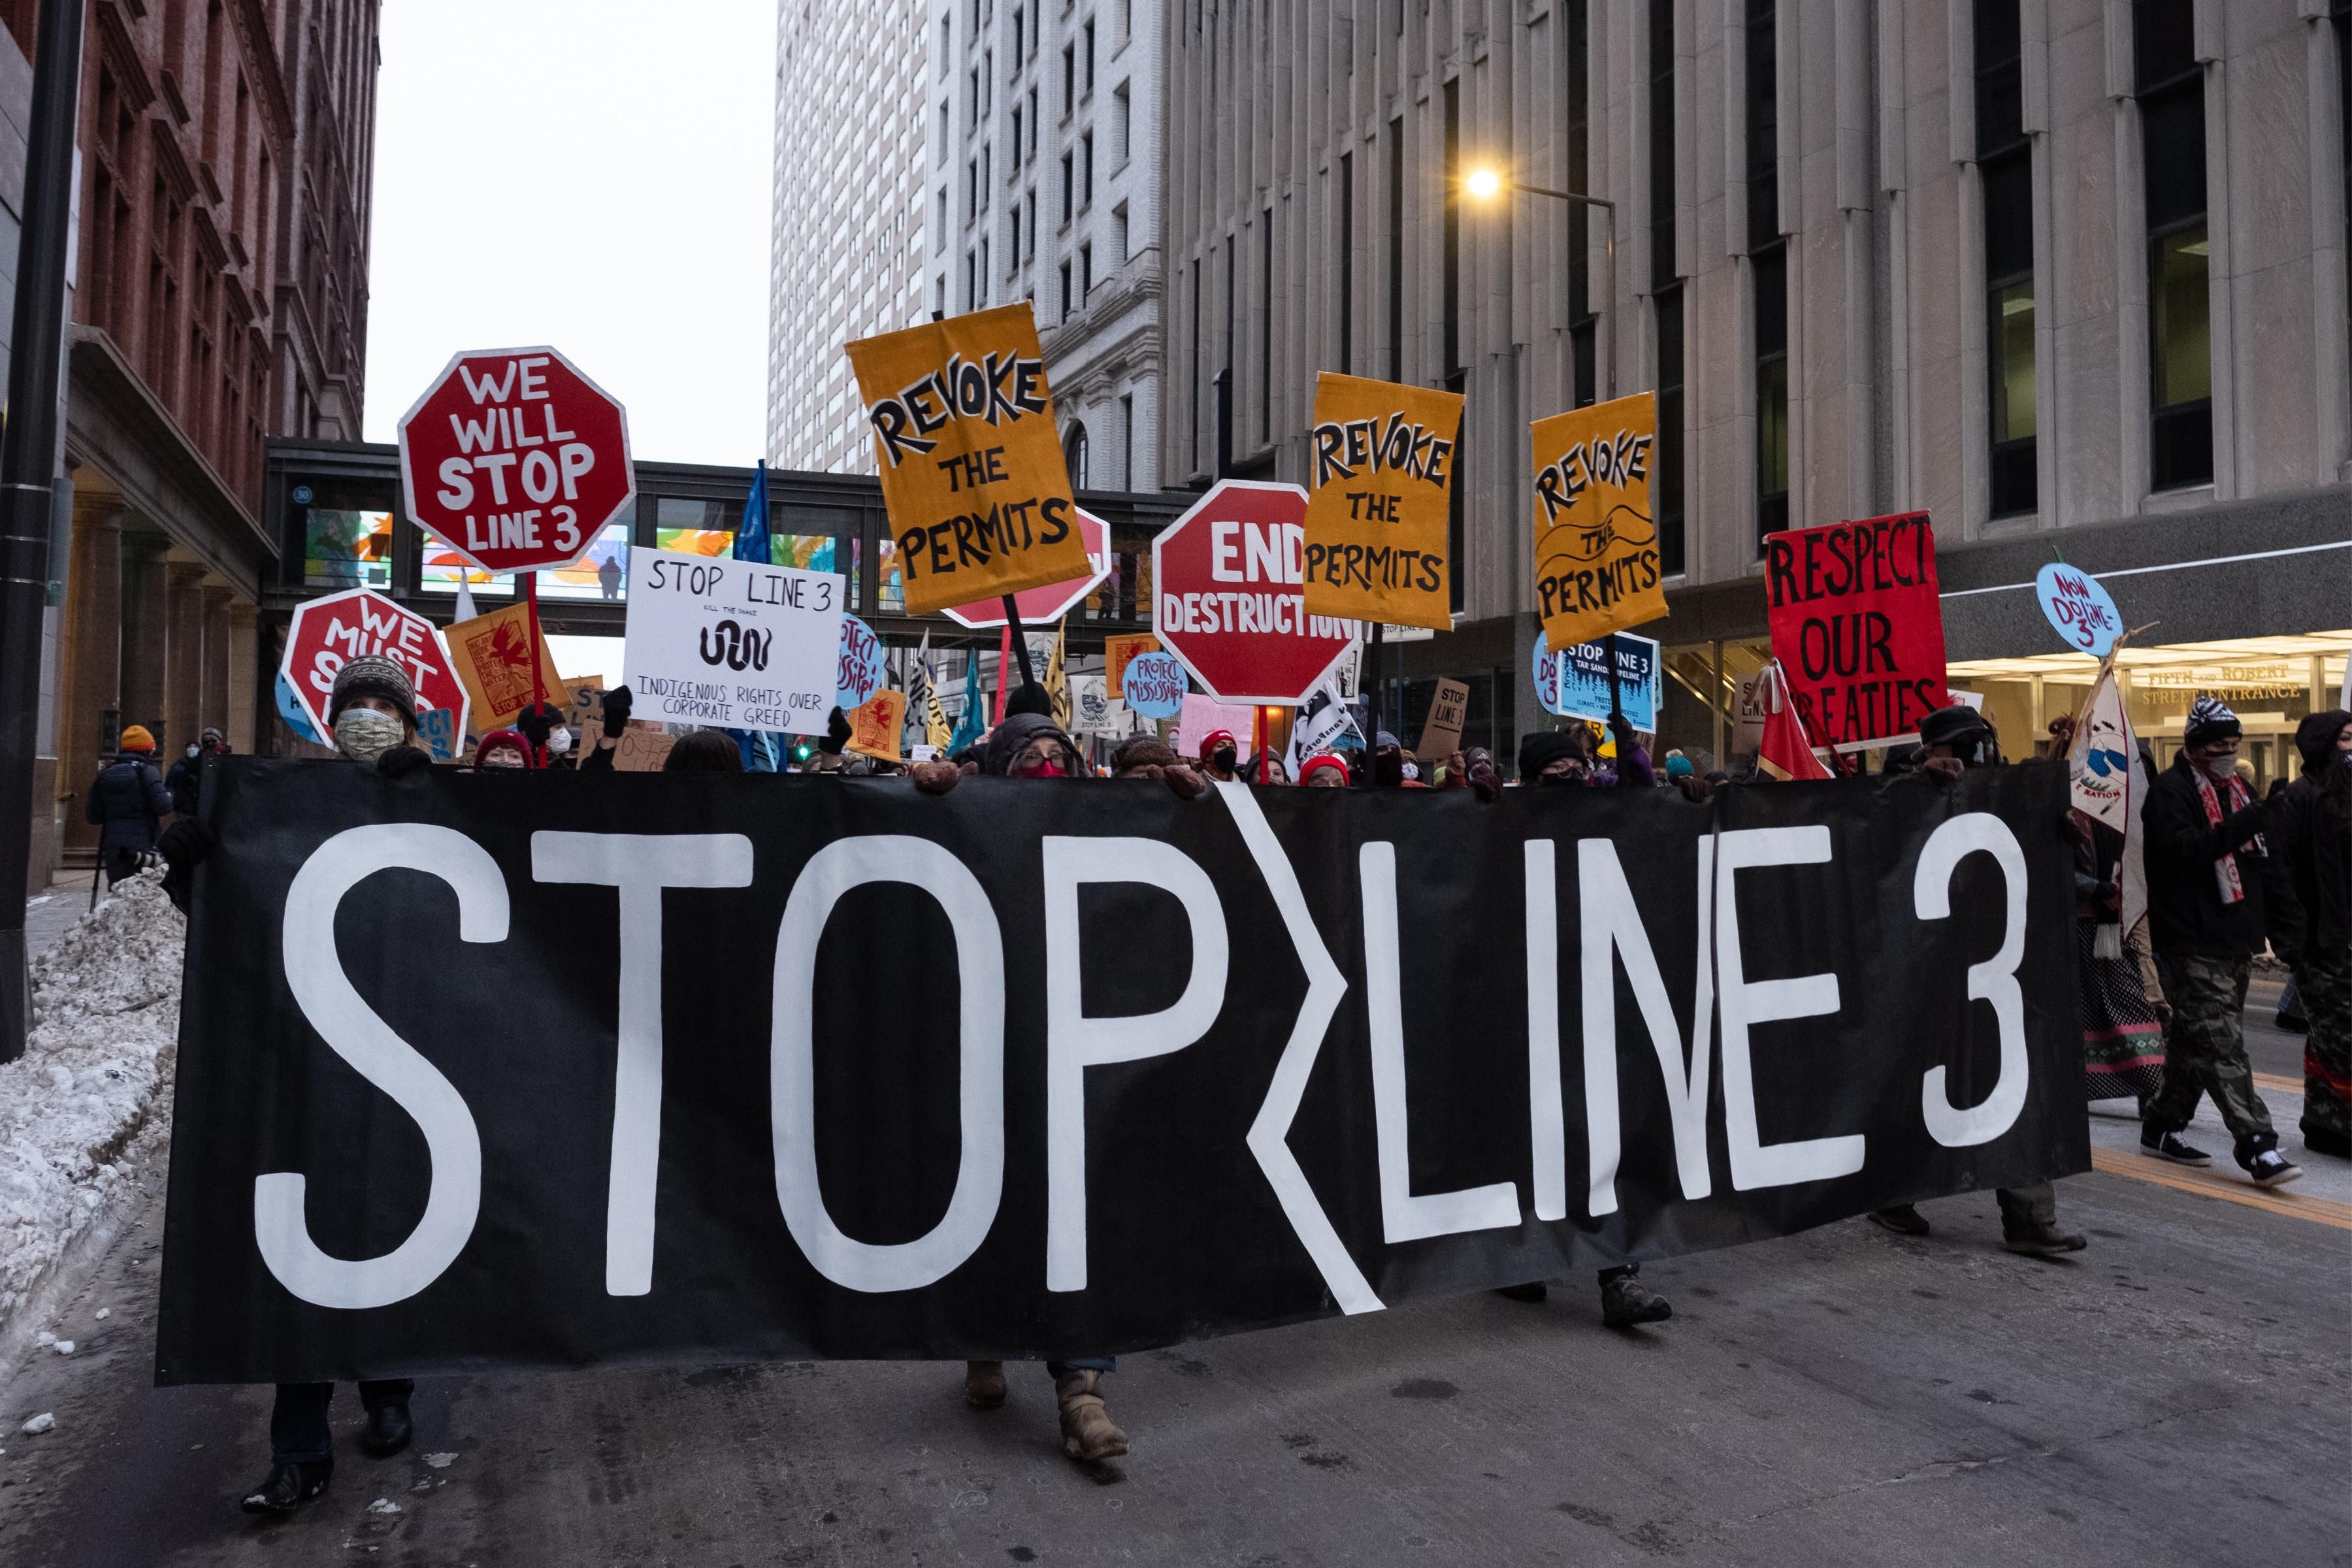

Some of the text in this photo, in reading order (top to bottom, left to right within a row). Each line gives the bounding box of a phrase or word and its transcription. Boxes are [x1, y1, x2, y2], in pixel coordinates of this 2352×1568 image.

[459, 357, 550, 404] WE
[449, 403, 576, 454] WILL
[870, 348, 1046, 468] REVOKE
[938, 446, 1009, 492] THE
[1313, 410, 1452, 489] REVOKE
[436, 442, 595, 510] STOP
[1535, 428, 1653, 527] REVOKE
[466, 505, 581, 552] LINE 3
[1346, 492, 1402, 523] THE
[898, 497, 1070, 580] PERMITS
[1211, 521, 1304, 584] END
[1580, 520, 1616, 555] THE
[1769, 515, 1931, 607] RESPECT
[647, 559, 832, 612] STOP LINE 3
[1304, 543, 1444, 593] PERMITS
[1538, 549, 1659, 619] PERMITS
[360, 596, 425, 656] WE
[1801, 612, 1899, 681] OUR
[2077, 619, 2094, 647] 3
[1567, 644, 1603, 661] STOP
[1615, 651, 1637, 670] INE
[1641, 659, 1648, 674] 3
[1576, 660, 1588, 670] TAR
[1616, 670, 1640, 680] IPELINE
[2149, 670, 2193, 685] FIFTH
[2222, 664, 2289, 681] ROBERT
[495, 698, 518, 713] STOP
[637, 676, 822, 711] INDIGENOUS RIGHTS OVER
[664, 698, 791, 727] CORPORATE GREED
[1435, 704, 1463, 725] LINE 3
[1441, 689, 1465, 704] STOP
[1595, 696, 1611, 706] PROTE
[2142, 683, 2300, 704] STREET ENTRANCE
[2083, 789, 2121, 798] NATION
[254, 812, 2029, 1309] STOP LINE 3
